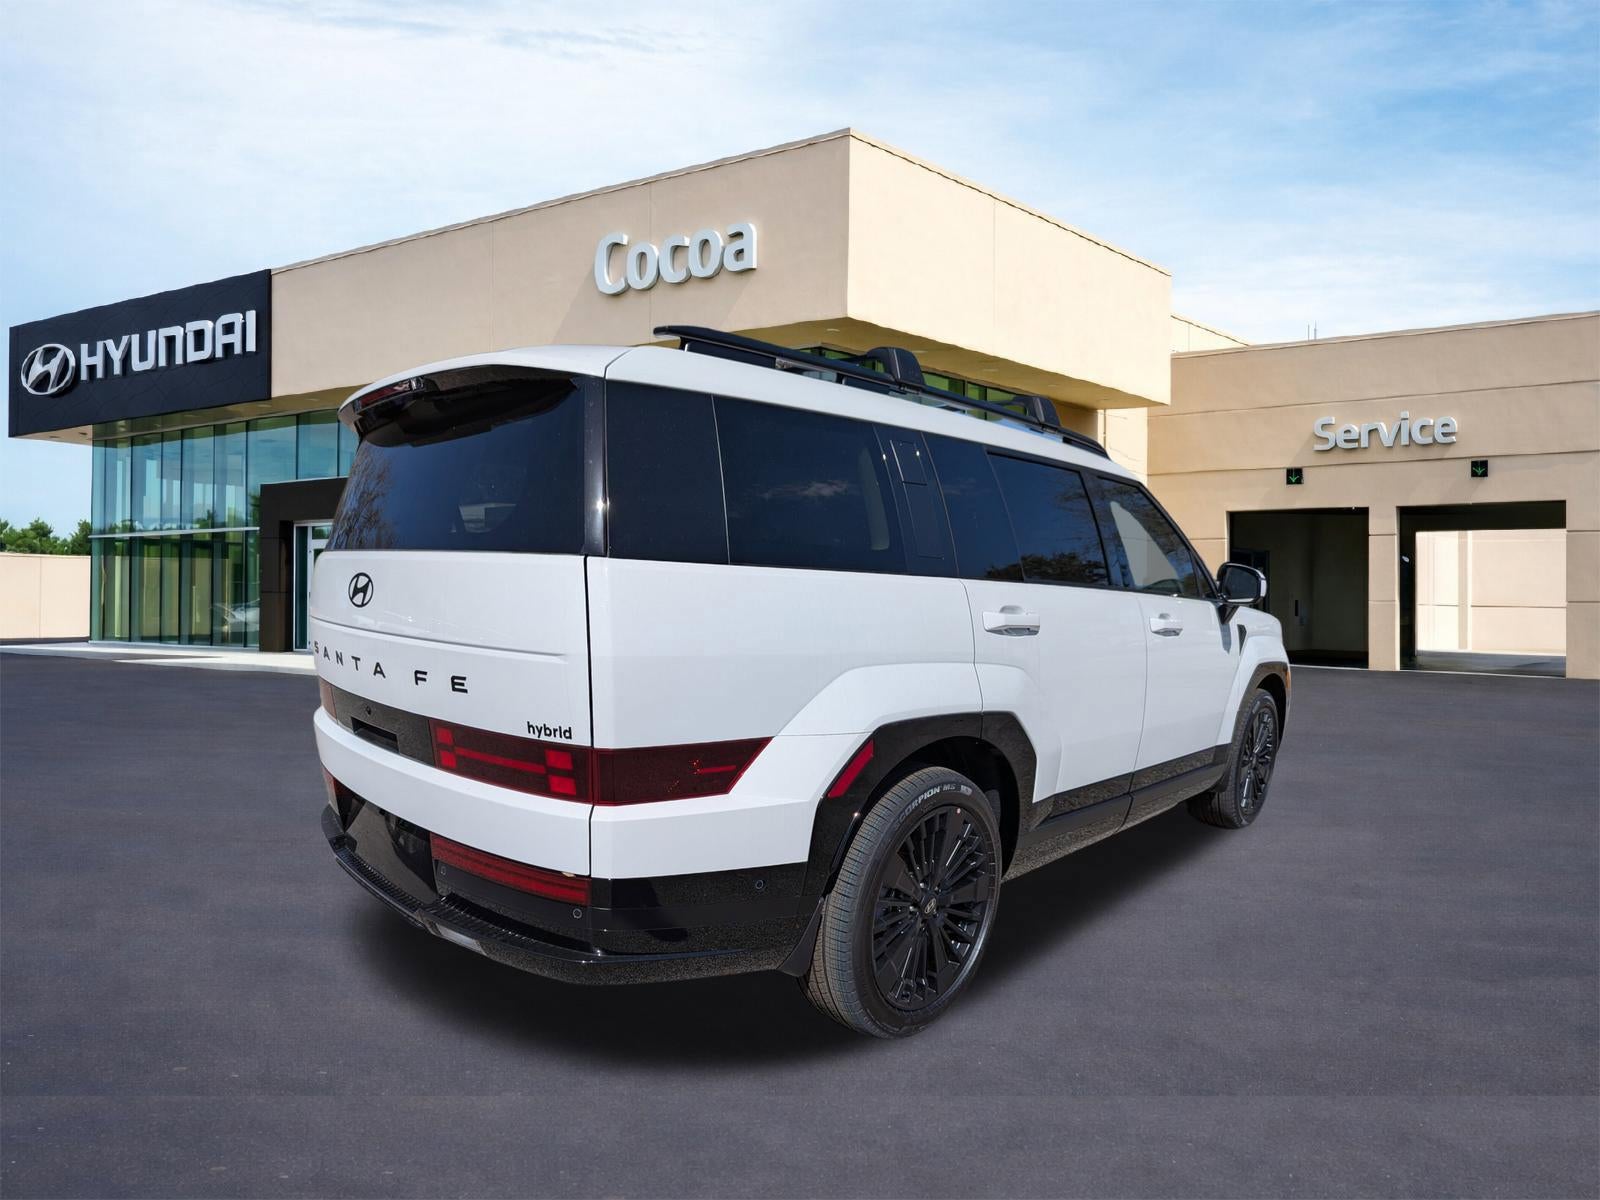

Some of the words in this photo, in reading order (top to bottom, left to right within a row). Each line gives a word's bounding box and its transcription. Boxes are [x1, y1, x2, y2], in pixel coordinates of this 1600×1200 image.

[594, 222, 757, 295] Cocoa
[80, 309, 257, 382] HYUNDAI
[1313, 410, 1458, 451] Service
[314, 640, 387, 679] SANTA
[414, 669, 468, 694] FE
[527, 721, 572, 740] hybrid
